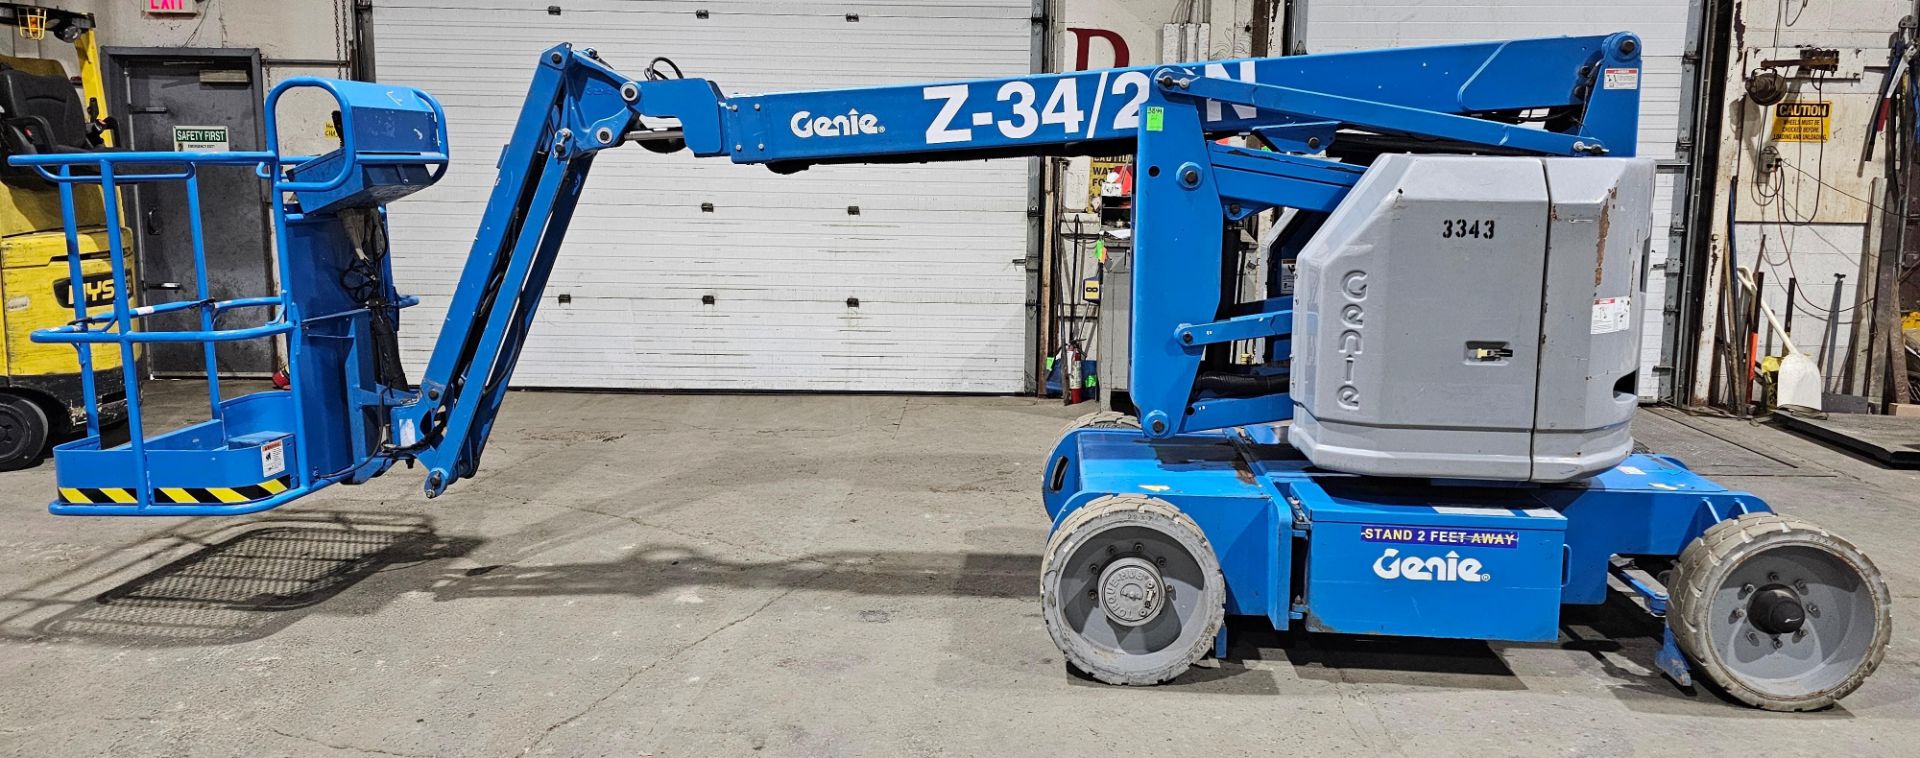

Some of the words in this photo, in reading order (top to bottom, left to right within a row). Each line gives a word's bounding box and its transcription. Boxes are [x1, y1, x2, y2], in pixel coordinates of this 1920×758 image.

[923, 61, 1257, 145] Z-34/2N
[1779, 104, 1827, 116] CAUTION
[177, 130, 203, 141] SAFETY
[204, 130, 225, 141] FIRST
[1442, 219, 1495, 240] 3343
[1364, 528, 1413, 541] STAND
[1417, 530, 1426, 542] 2
[1430, 531, 1467, 543] FEET
[1471, 532, 1516, 546] AWAY
